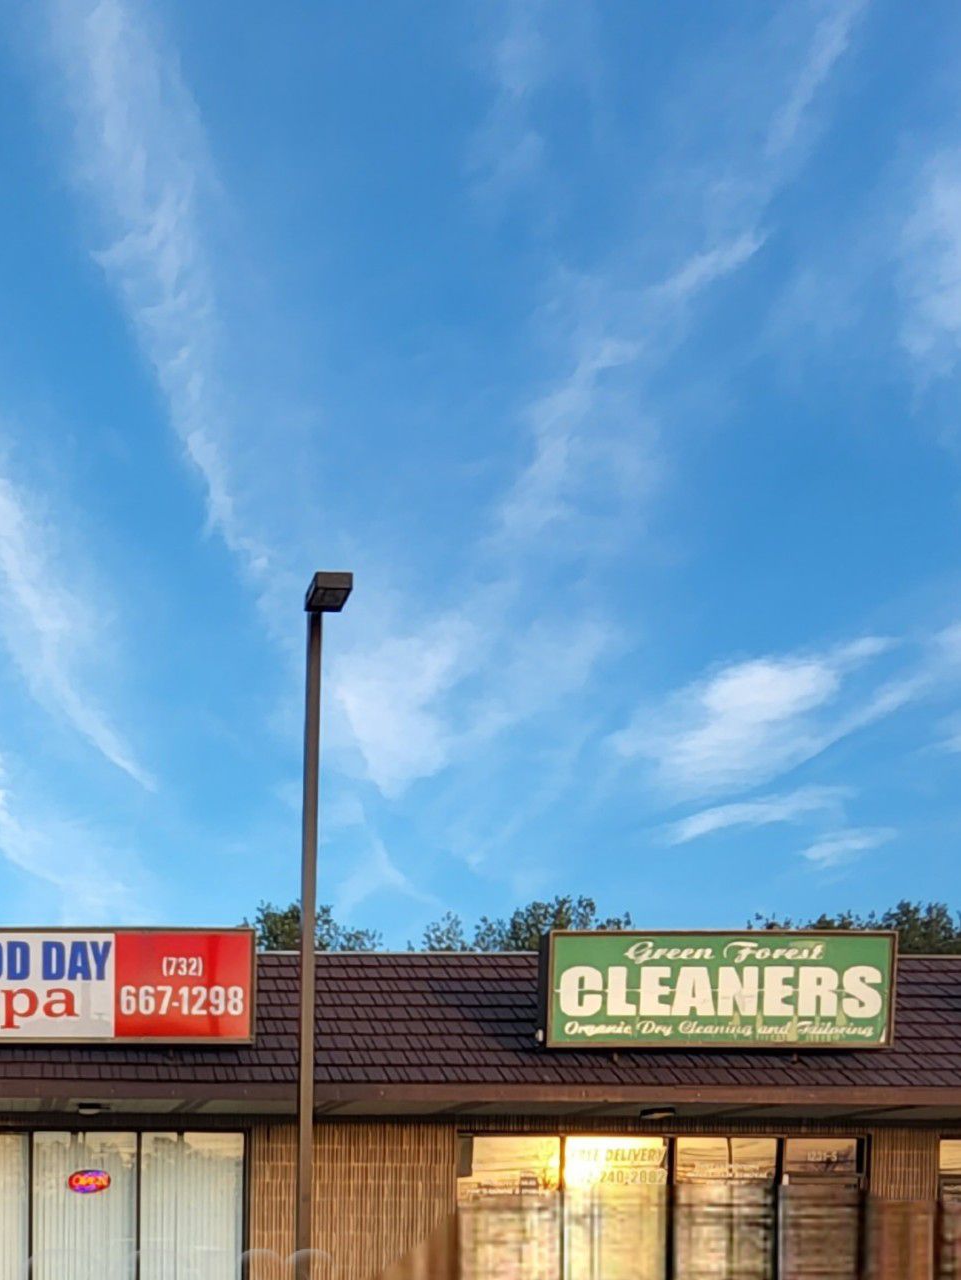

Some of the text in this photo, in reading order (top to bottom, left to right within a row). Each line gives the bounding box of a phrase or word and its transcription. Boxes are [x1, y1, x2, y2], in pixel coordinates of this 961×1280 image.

[42, 940, 112, 981] DAY
[624, 941, 824, 965] Green Forest
[162, 957, 203, 977] (732)
[120, 985, 244, 1016] 667-1298
[559, 965, 882, 1018] CLEANERS
[564, 1020, 874, 1037] Organic Dry Cleaning and Tailoring
[605, 1146, 665, 1161] DELIVERY
